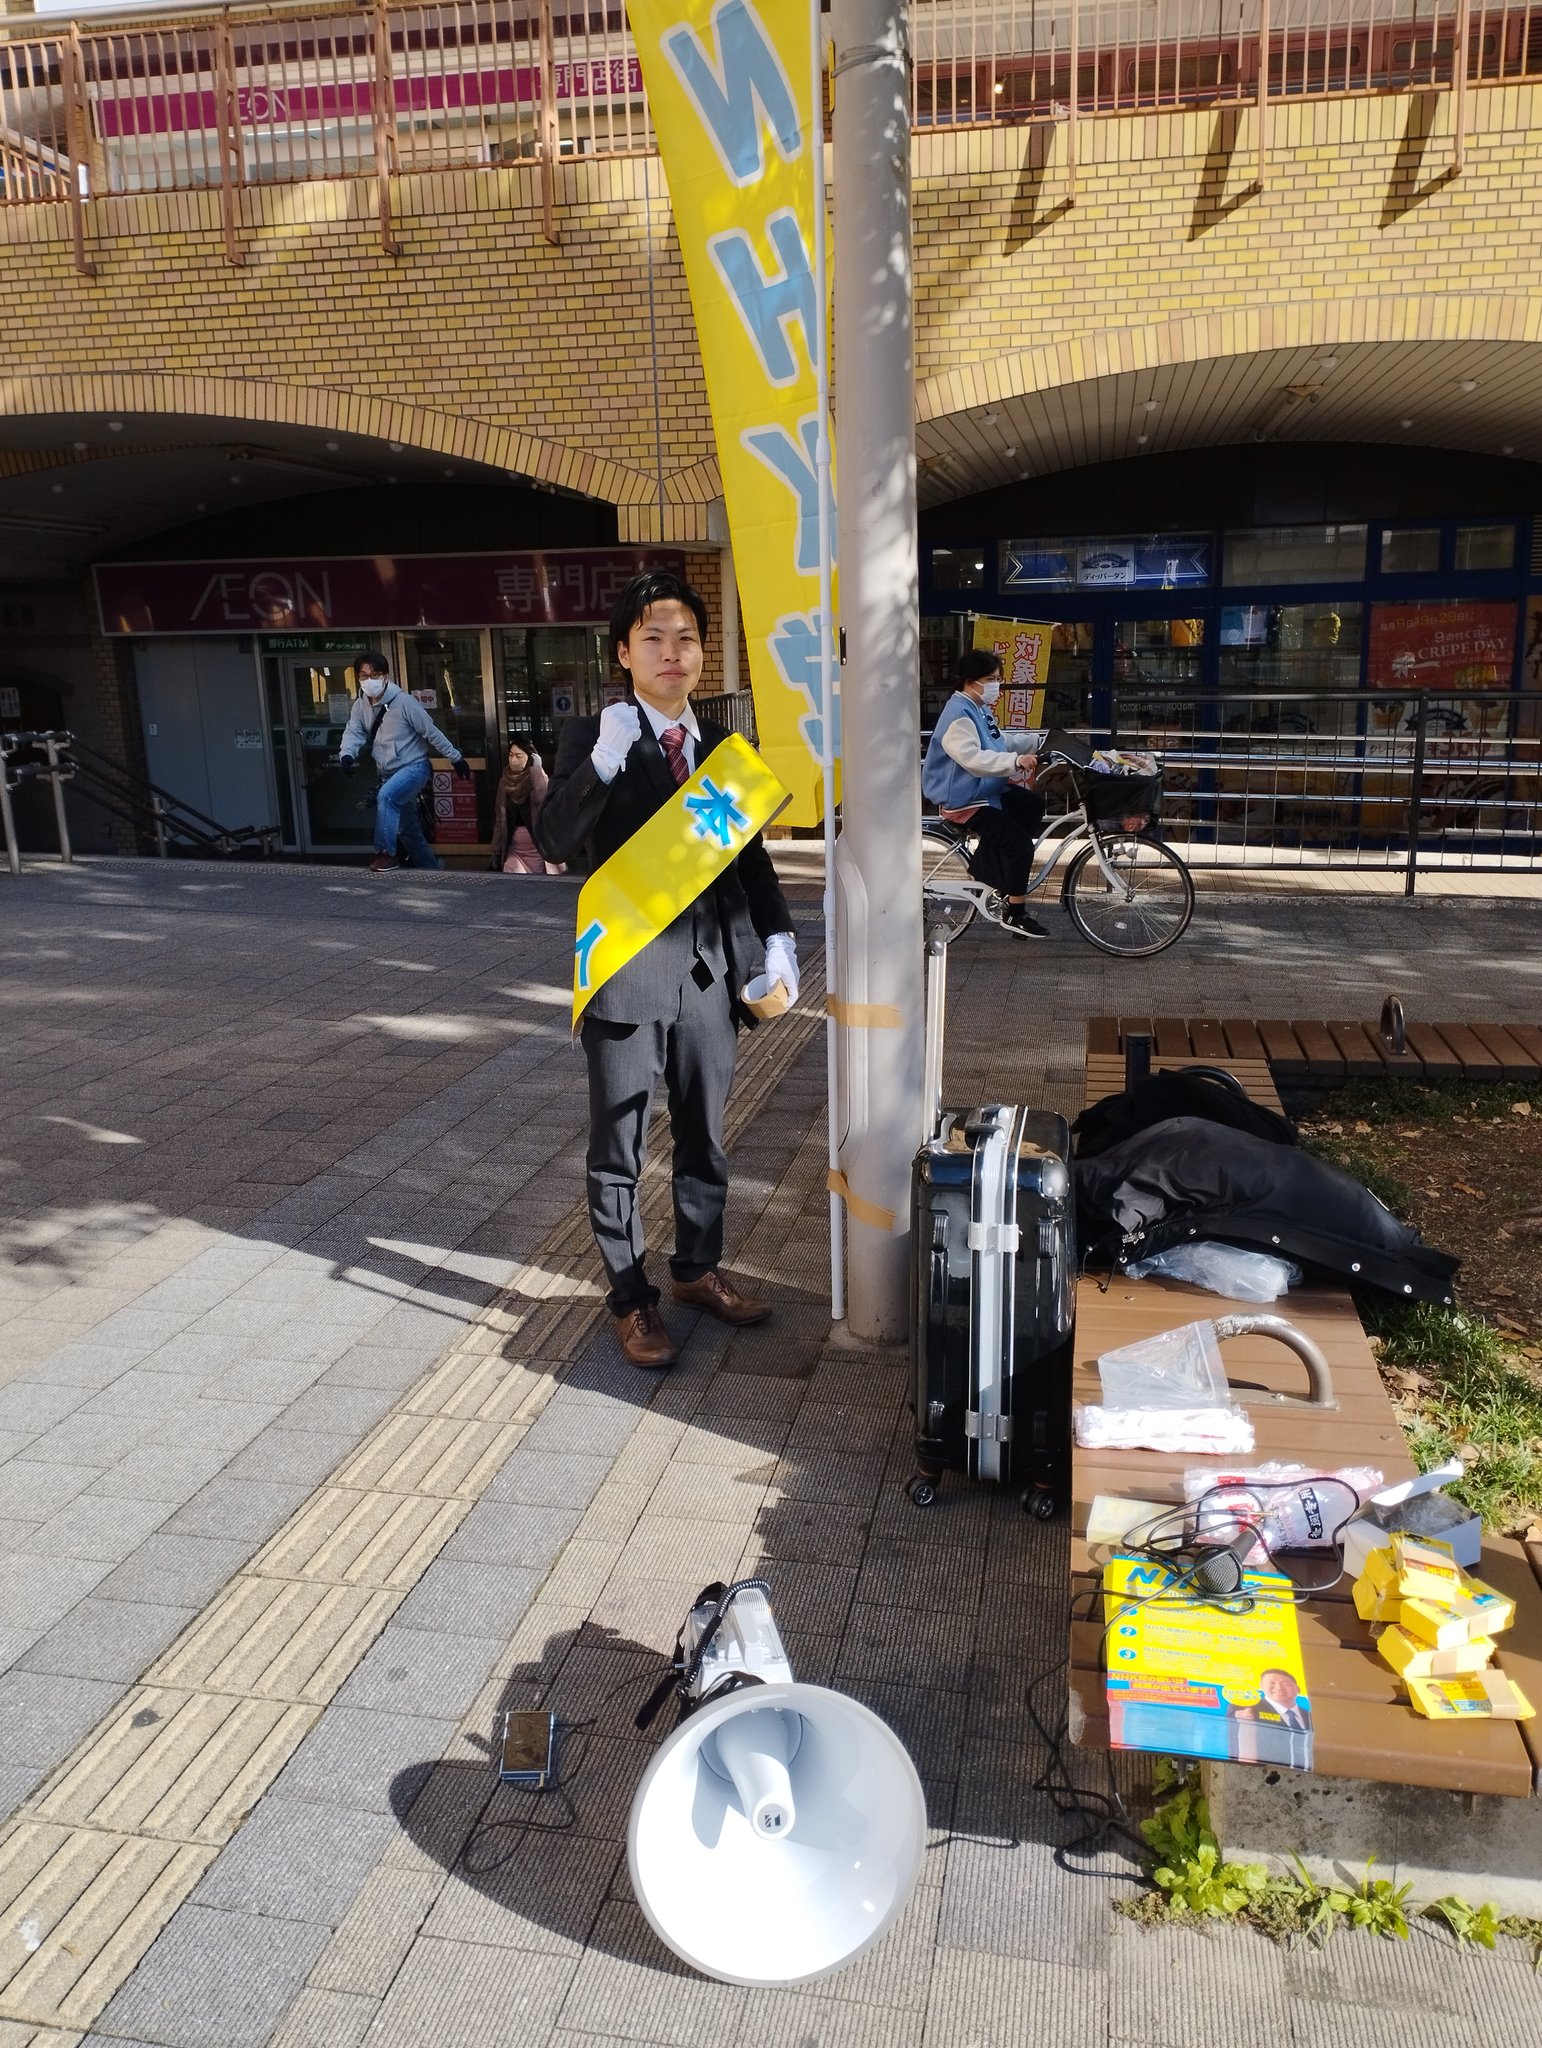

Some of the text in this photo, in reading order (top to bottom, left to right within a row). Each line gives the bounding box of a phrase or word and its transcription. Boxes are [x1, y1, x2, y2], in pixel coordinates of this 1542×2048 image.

[225, 91, 292, 122] EON
[494, 558, 680, 614] 専門店
[1418, 636, 1508, 660] CREPE DAY
